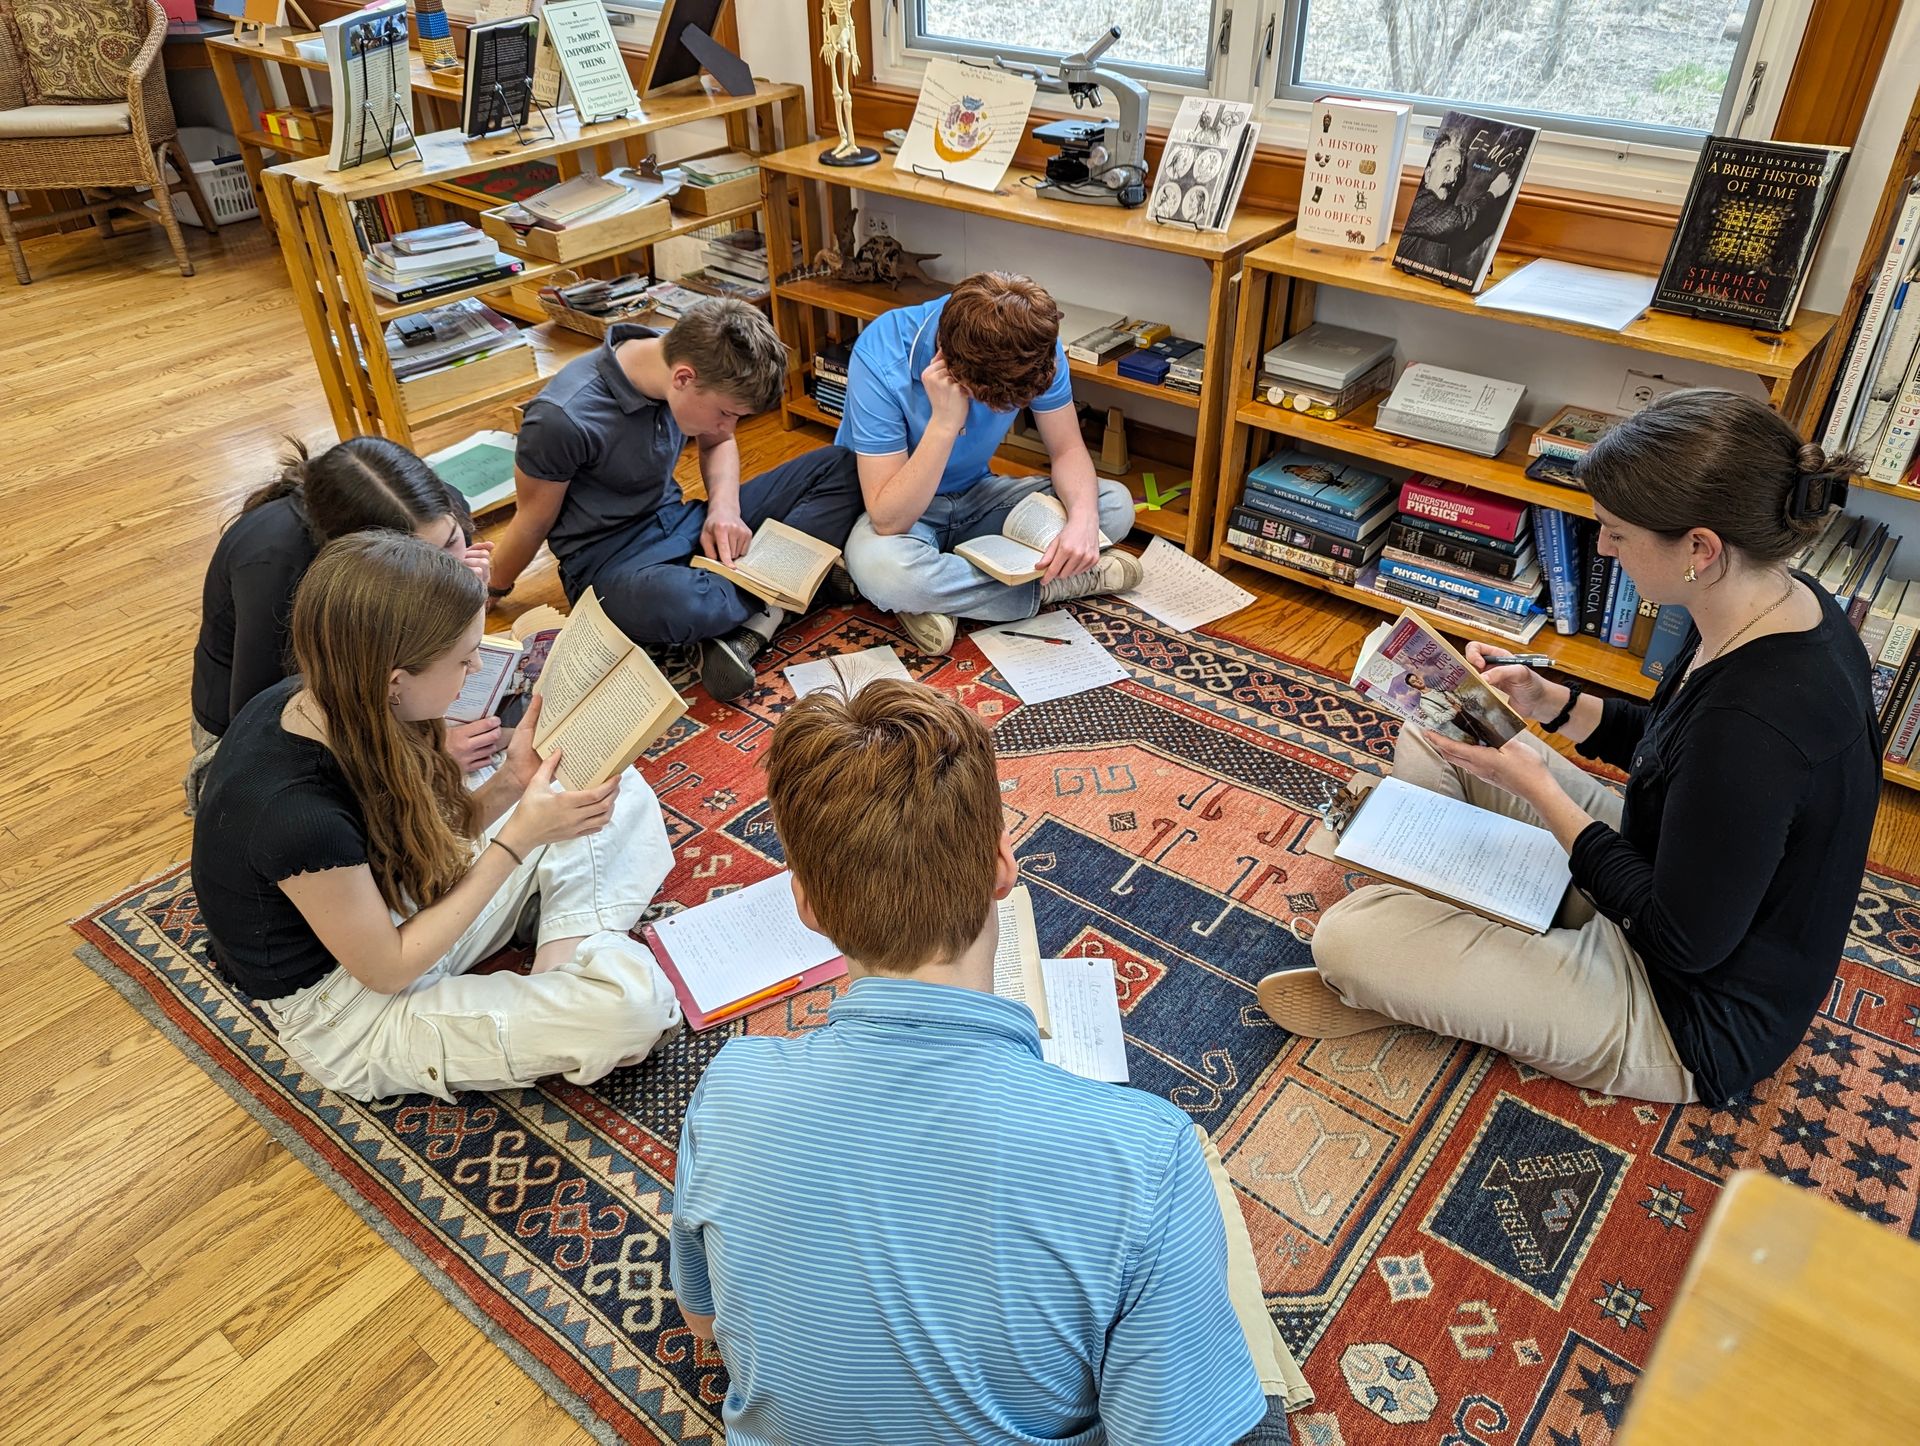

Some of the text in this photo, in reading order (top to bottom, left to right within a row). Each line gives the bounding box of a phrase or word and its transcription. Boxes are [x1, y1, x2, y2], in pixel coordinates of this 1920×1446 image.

[577, 29, 601, 42] MOST
[564, 41, 612, 58] IMPORTANT
[579, 56, 606, 69] THING
[1318, 138, 1379, 155] A HISTORY
[1714, 150, 1737, 160] THE
[1337, 158, 1353, 169] OF
[1708, 161, 1825, 188] A BRIEF HISTORY
[1310, 171, 1377, 191] THE WORLD
[1727, 179, 1798, 200] OF TIME
[1333, 193, 1345, 204] IN
[1304, 206, 1372, 226] 100 OBJECTS
[1886, 259, 1898, 273] The
[1688, 266, 1770, 290] STEPHEN
[1662, 291, 1695, 301] UPDATED
[1682, 279, 1766, 304] HAWKING
[1869, 274, 1892, 320] Constitution
[1851, 346, 1866, 373] United
[1844, 372, 1858, 396] States
[1830, 404, 1845, 435] America
[1547, 448, 1580, 460] SCIENC
[1273, 488, 1332, 511] NATURE'S BEST HOPE
[1408, 492, 1475, 516] UNDERSTANDING
[1406, 500, 1459, 522] PHYSICS
[1262, 519, 1278, 539] LIFE
[1439, 528, 1447, 536] THE
[1458, 533, 1479, 543] GRAVITY
[1299, 550, 1331, 568] PLANTS
[1392, 566, 1438, 587] PHYSICAL
[1438, 580, 1480, 598] SCIENCE
[1586, 557, 1605, 614] SCIENCIA
[1409, 631, 1424, 647] HUNT
[1884, 625, 1905, 660] COURAGE
[1892, 625, 1913, 662] UNDAUNTED
[1408, 640, 1438, 669] Across
[1433, 653, 1452, 671] Five
[1440, 664, 1466, 690] Aprils
[1881, 661, 1917, 734] FLIGHT FROM MONTICELLO
[1376, 695, 1426, 727] Across Five Aprils
[1896, 703, 1920, 750] GOVERNMENT
